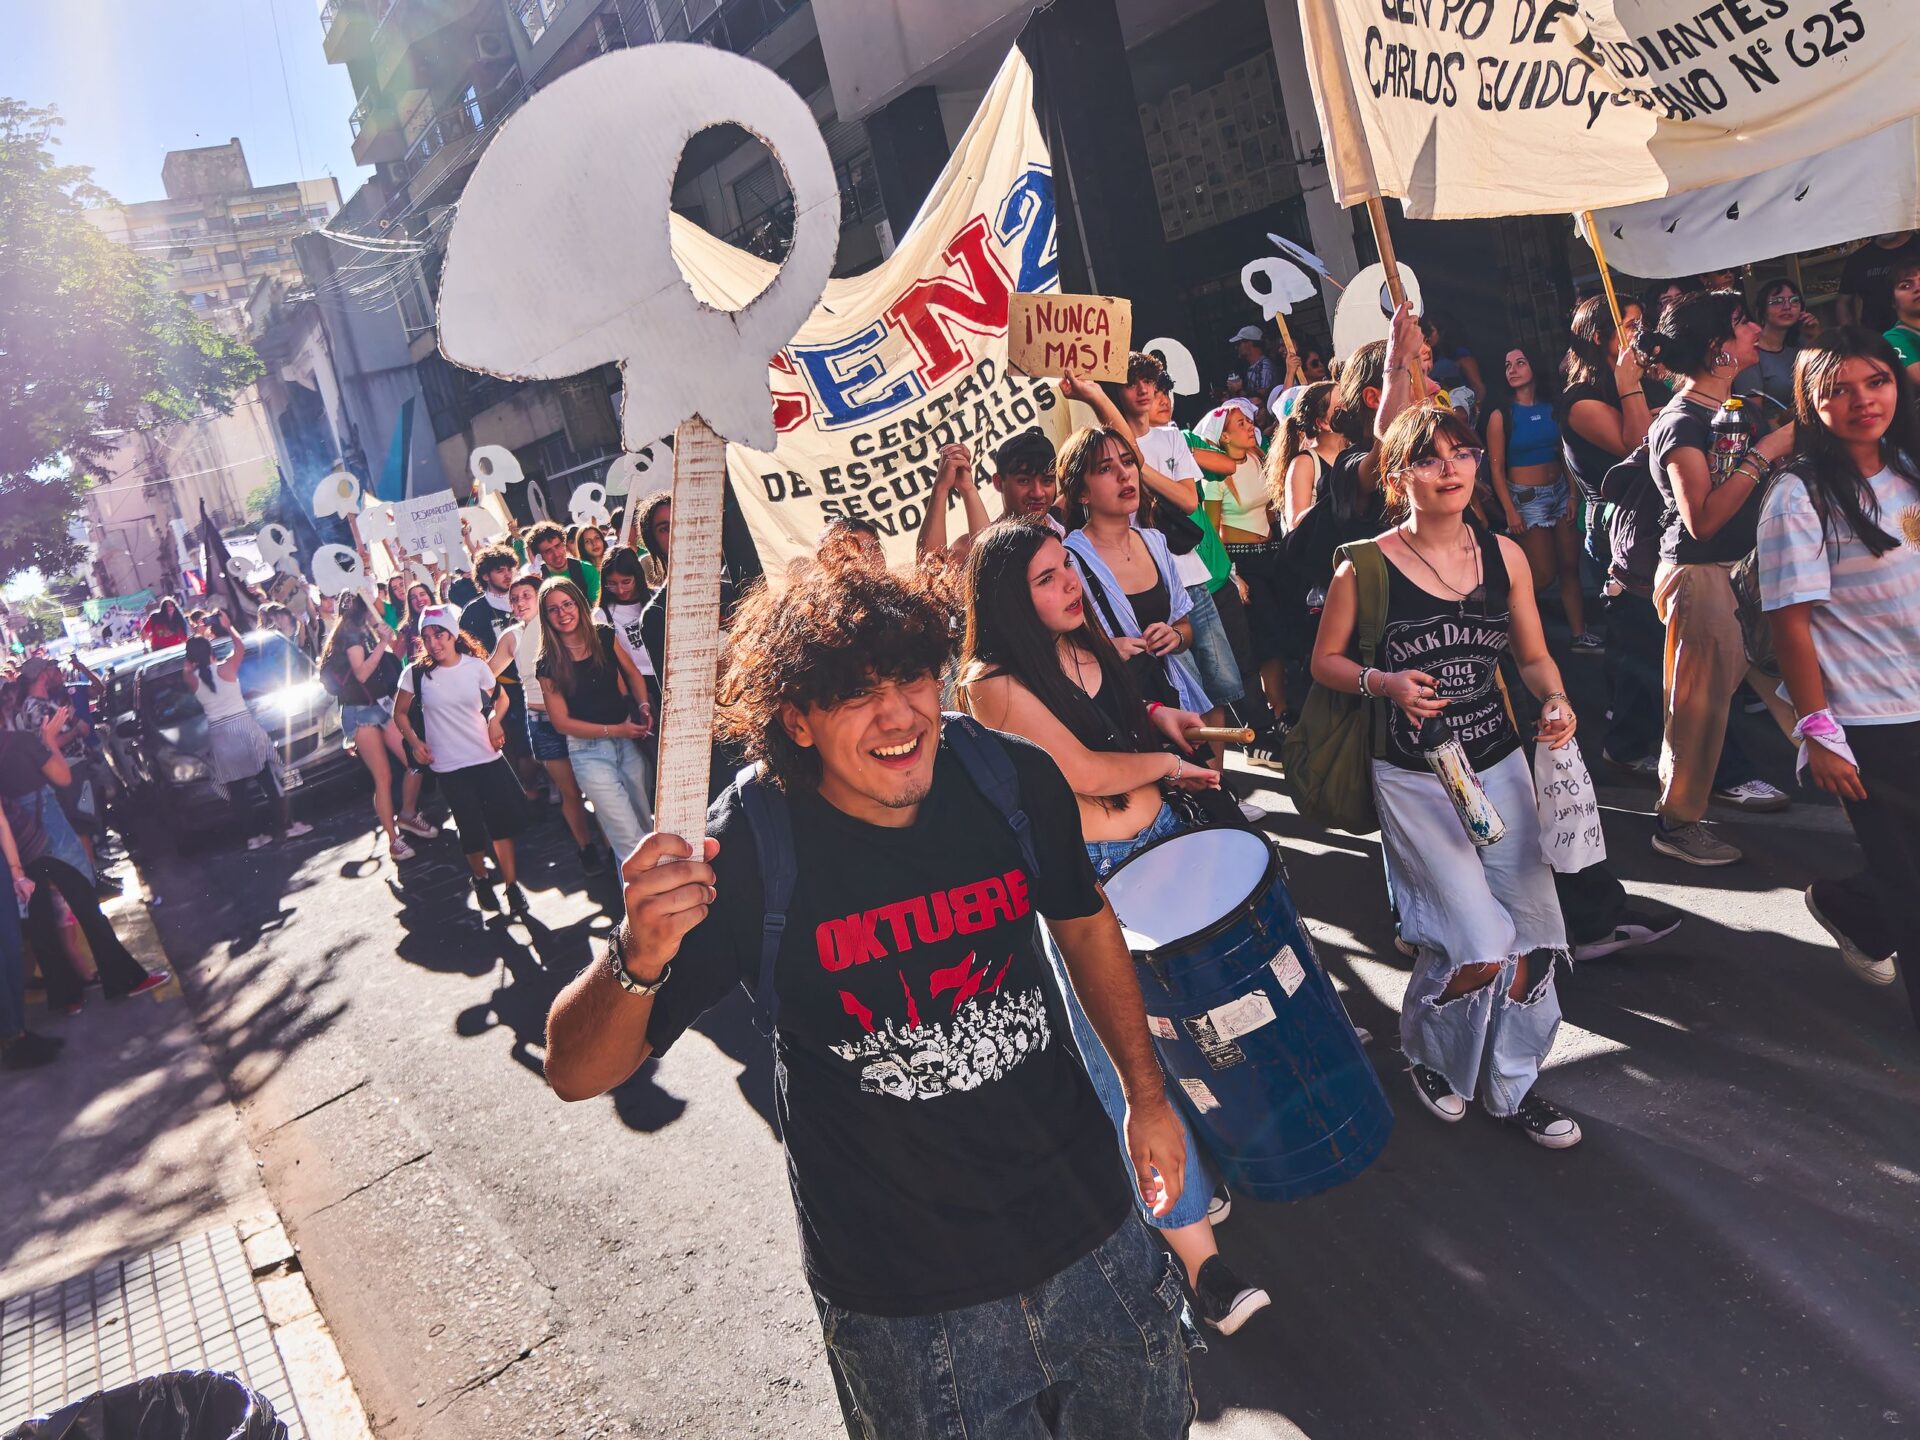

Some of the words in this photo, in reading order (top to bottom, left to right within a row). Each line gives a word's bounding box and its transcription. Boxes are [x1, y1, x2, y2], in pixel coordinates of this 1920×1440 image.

[1510, 0, 1579, 44] DE
[1364, 25, 1465, 108] CARLOS
[1477, 56, 1595, 111] GUIDO
[1785, 3, 1866, 68] 625
[1025, 301, 1110, 345] ¡NUNCA
[1044, 336, 1111, 371] MÁS!
[761, 470, 812, 502] DE
[1390, 630, 1441, 663] JACK
[1441, 662, 1473, 677] Old
[1441, 686, 1475, 696] BRAND
